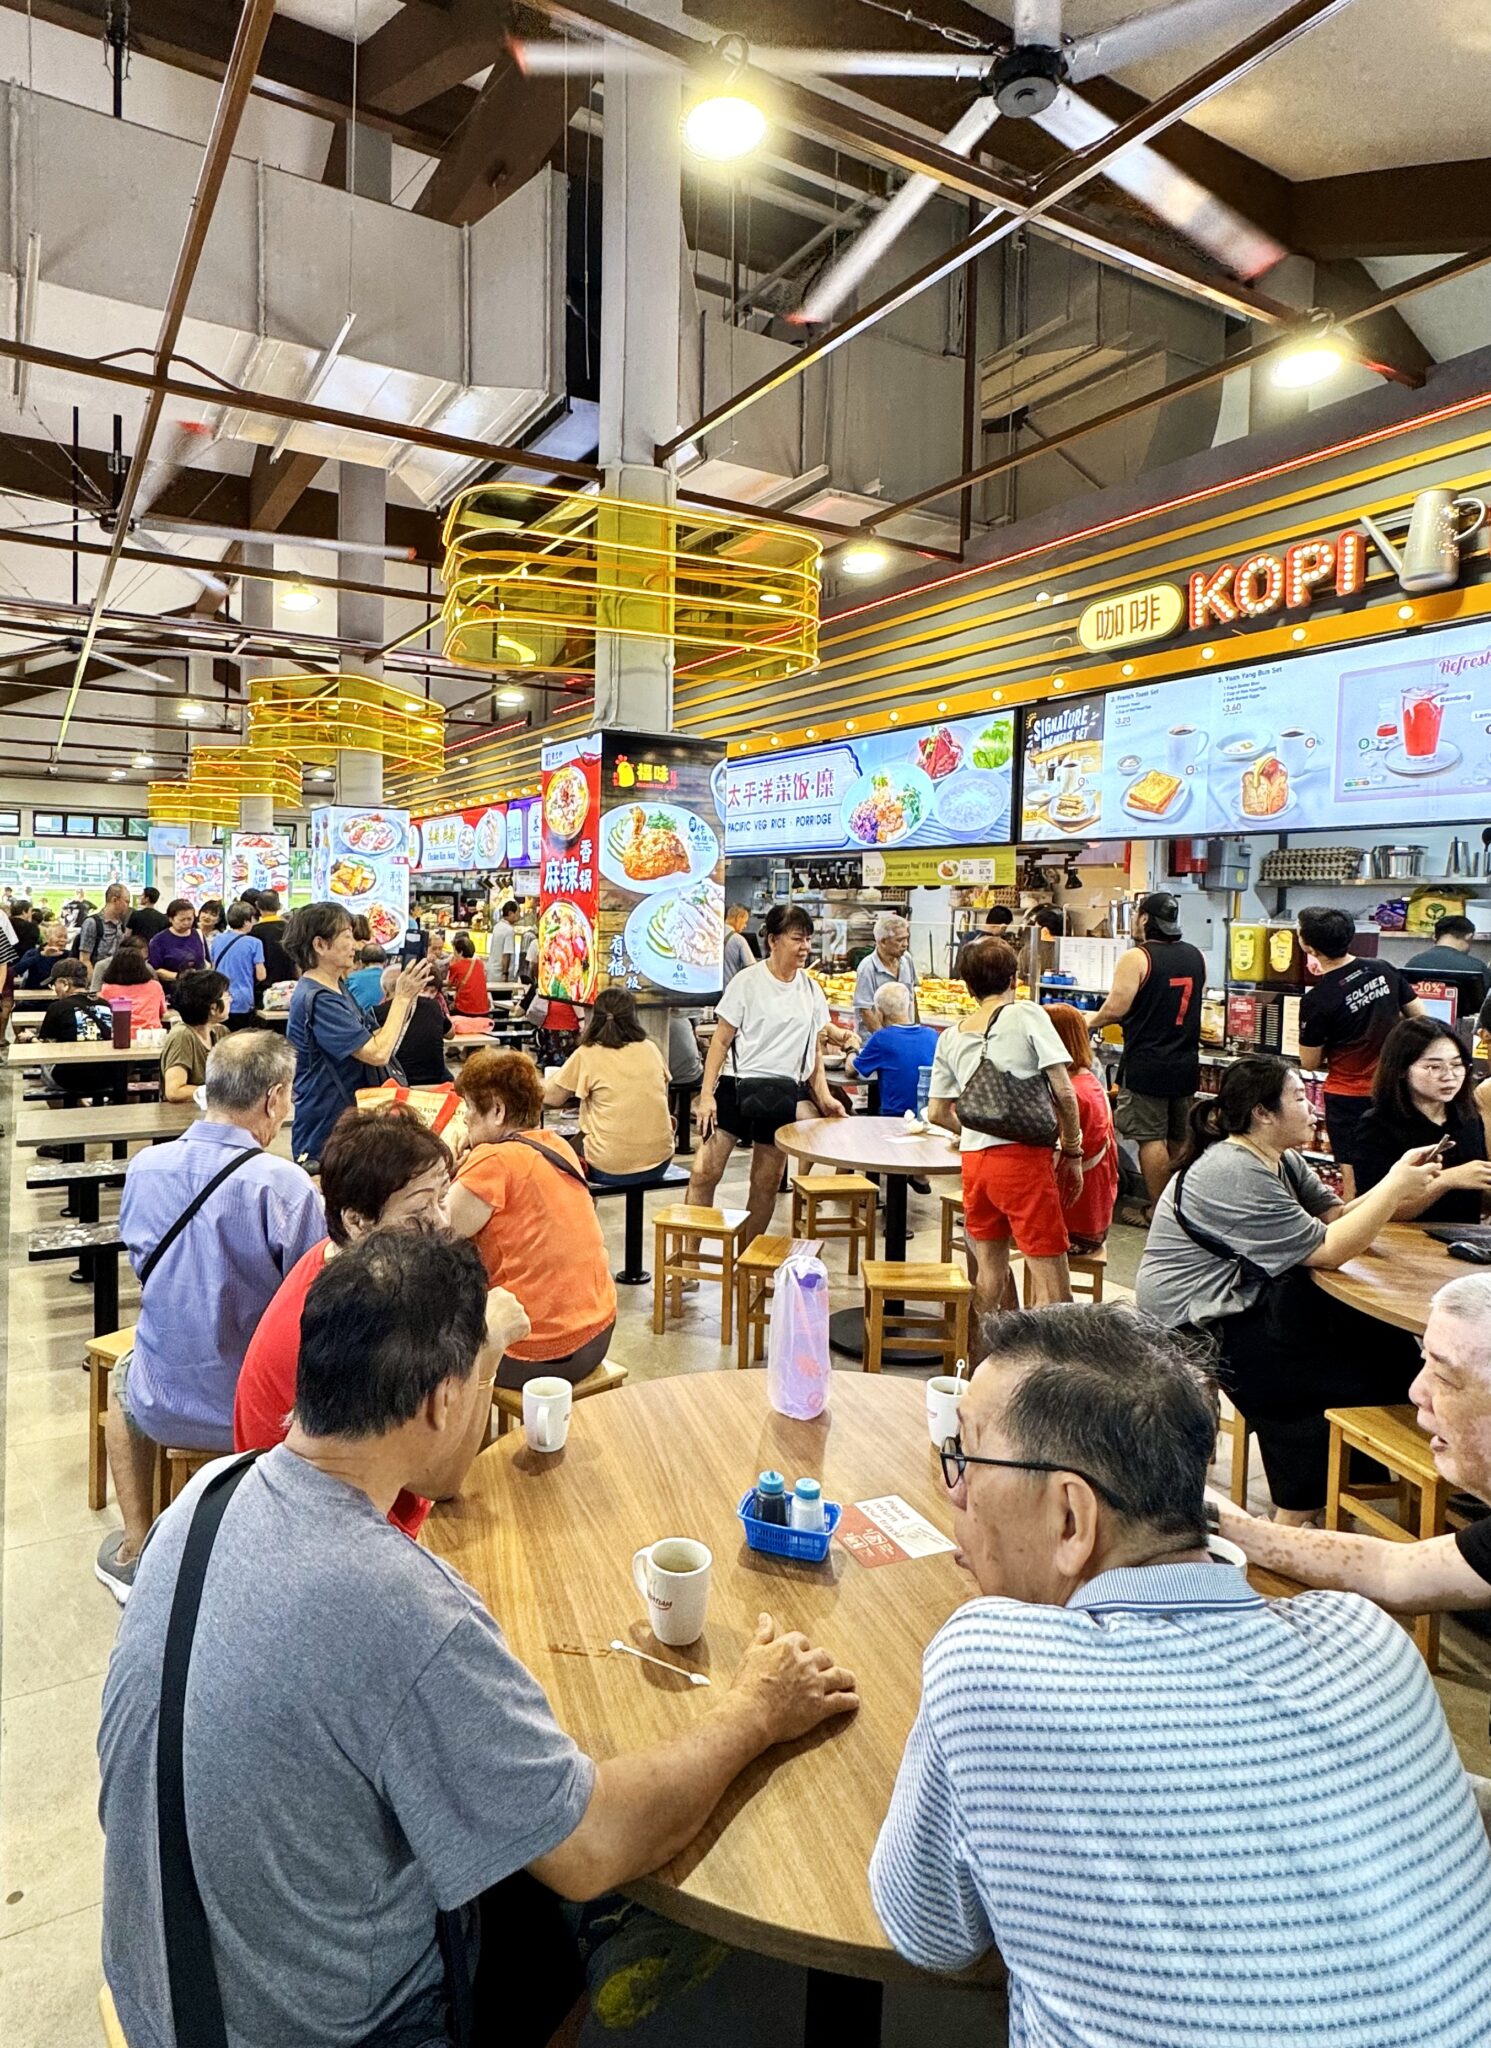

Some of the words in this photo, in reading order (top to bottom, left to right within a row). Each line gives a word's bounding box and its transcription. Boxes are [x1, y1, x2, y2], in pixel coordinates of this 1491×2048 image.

[1188, 530, 1368, 630] KOPI
[1095, 593, 1162, 641] 咖啡
[1033, 705, 1090, 741] SIGNATURE
[1076, 726, 1089, 740] SET
[727, 821, 751, 832] PACIFIC
[754, 819, 768, 830] VEG
[771, 818, 786, 829] RICE
[795, 813, 832, 827] PORRDGE
[543, 856, 580, 894] 麻辣
[1169, 976, 1193, 1025] 7
[1345, 975, 1386, 1006] SOLDIER
[1349, 984, 1390, 1013] STRONG
